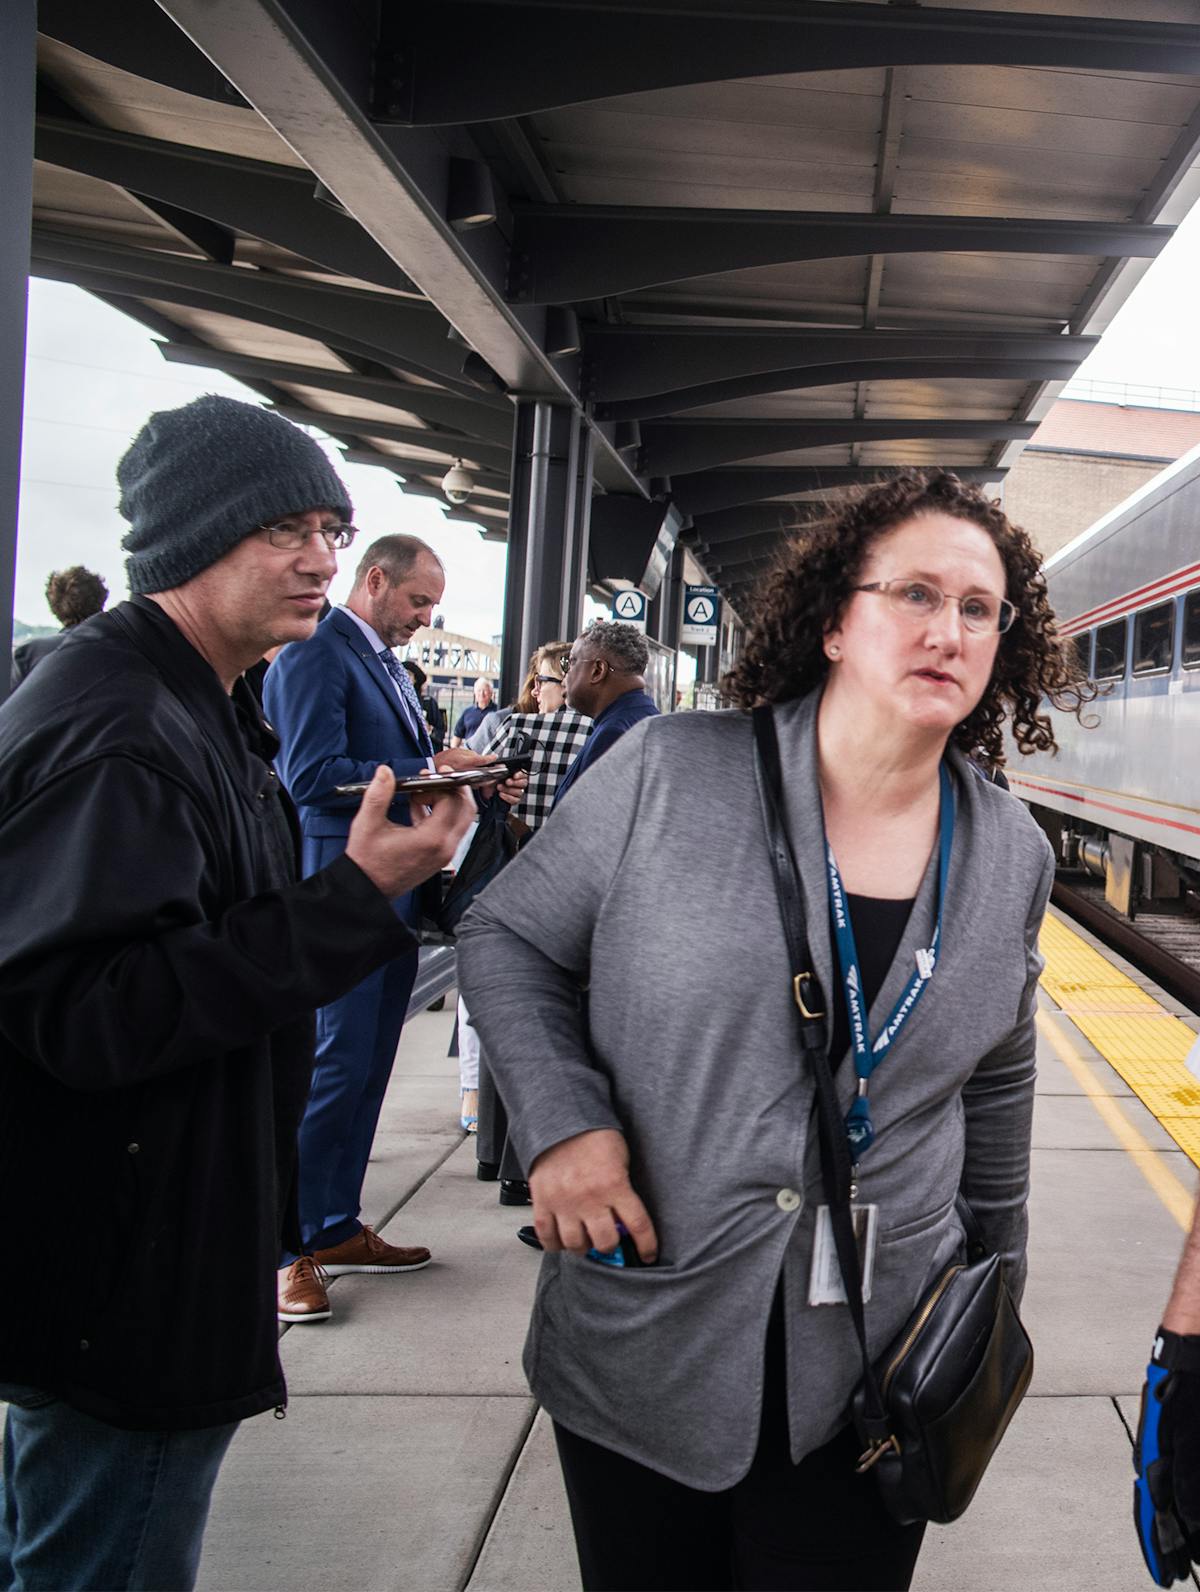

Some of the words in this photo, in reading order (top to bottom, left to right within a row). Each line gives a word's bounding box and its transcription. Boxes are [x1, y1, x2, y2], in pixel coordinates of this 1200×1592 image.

[621, 596, 637, 613] A
[693, 601, 708, 618] A
[829, 868, 846, 928] AMTRAK
[848, 991, 866, 1053] AMTRAK
[888, 978, 924, 1036] AMTRAK
